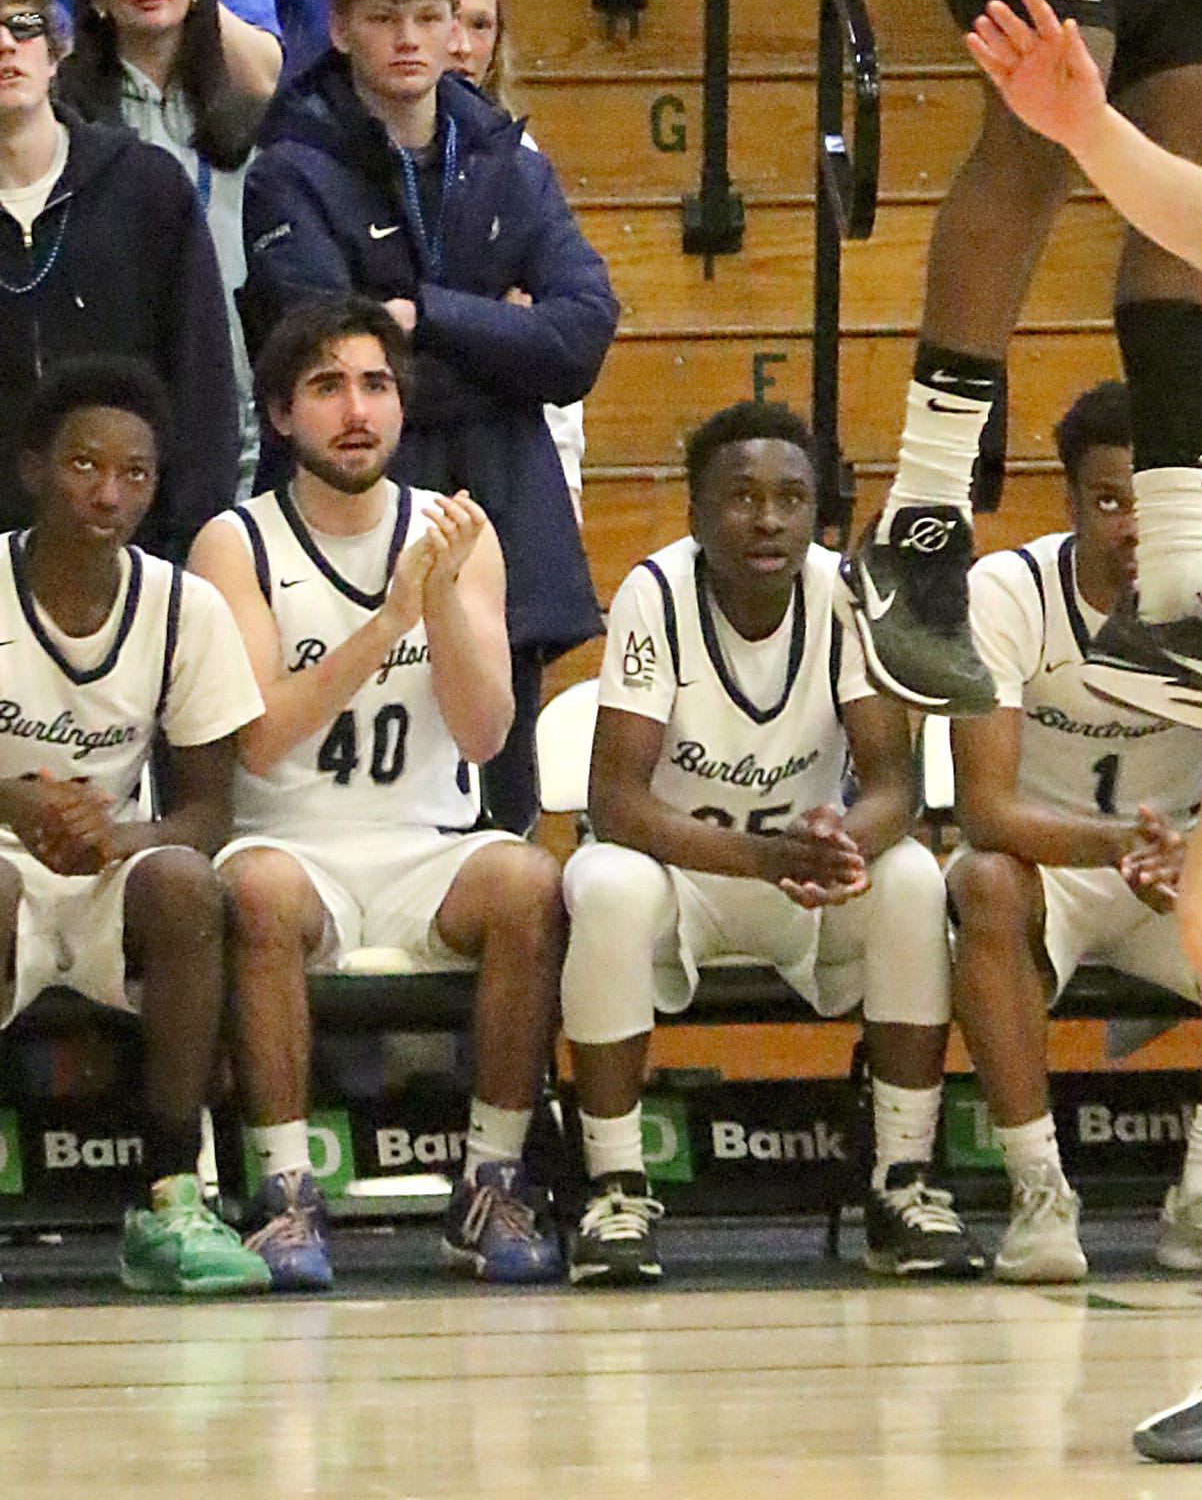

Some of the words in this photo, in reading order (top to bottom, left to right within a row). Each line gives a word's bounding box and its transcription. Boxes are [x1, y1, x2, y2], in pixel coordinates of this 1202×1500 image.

[650, 94, 687, 153] G
[0, 700, 136, 760] Burlington
[317, 703, 410, 786] 40
[670, 740, 819, 798] Burlington
[1092, 753, 1119, 815] 1
[44, 1131, 144, 1169] Ban
[711, 1121, 847, 1160] Bank
